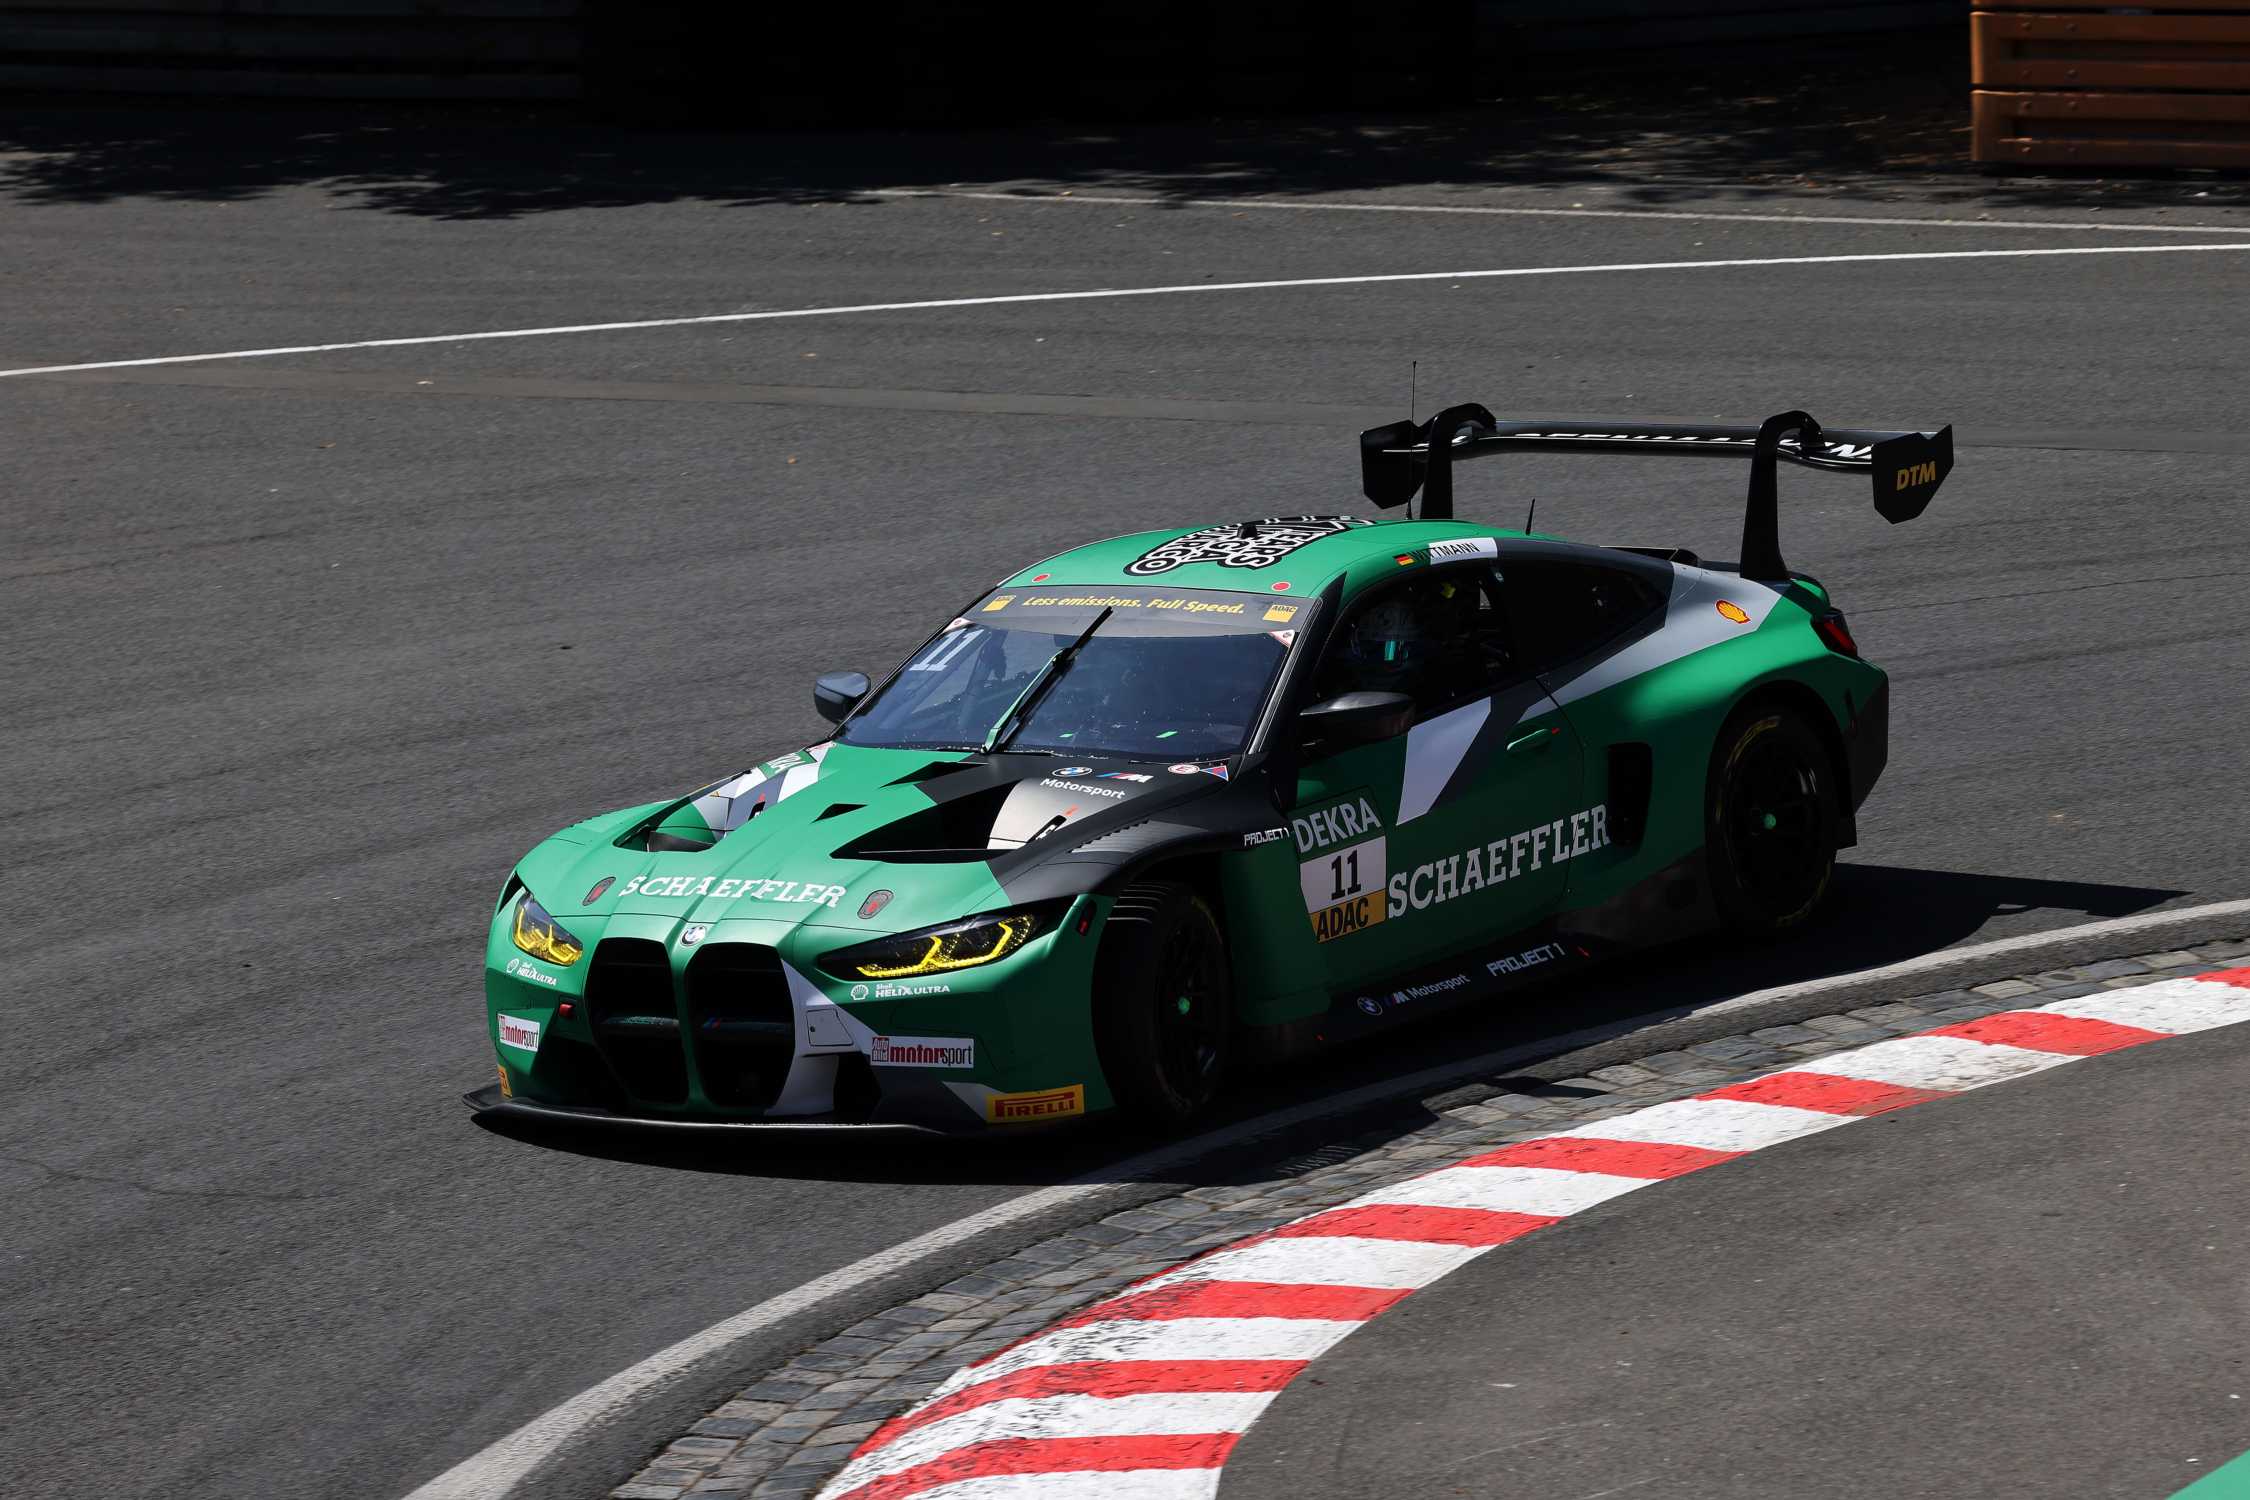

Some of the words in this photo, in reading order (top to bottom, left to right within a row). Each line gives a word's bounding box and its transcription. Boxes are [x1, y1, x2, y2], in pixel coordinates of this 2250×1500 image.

[1896, 461, 1936, 491] DTM
[1021, 596, 1058, 606] Less
[1058, 596, 1141, 608] emissions.
[1146, 598, 1183, 609] Full
[1184, 600, 1244, 614] Speed.
[909, 628, 984, 671] 11
[1040, 778, 1126, 799] Motorsport
[1292, 797, 1383, 854] DEKRA
[1331, 850, 1362, 901] 11
[1388, 804, 1611, 919] SCHAEFFLER
[619, 875, 847, 908] SCHAEFFLER
[1316, 897, 1370, 942] ADAC
[875, 986, 914, 998] HELIX
[914, 985, 951, 995] ULTRA
[1407, 974, 1471, 999] Motorsport
[889, 1044, 973, 1066] motorsport
[995, 1091, 1076, 1118] PIRELLI
